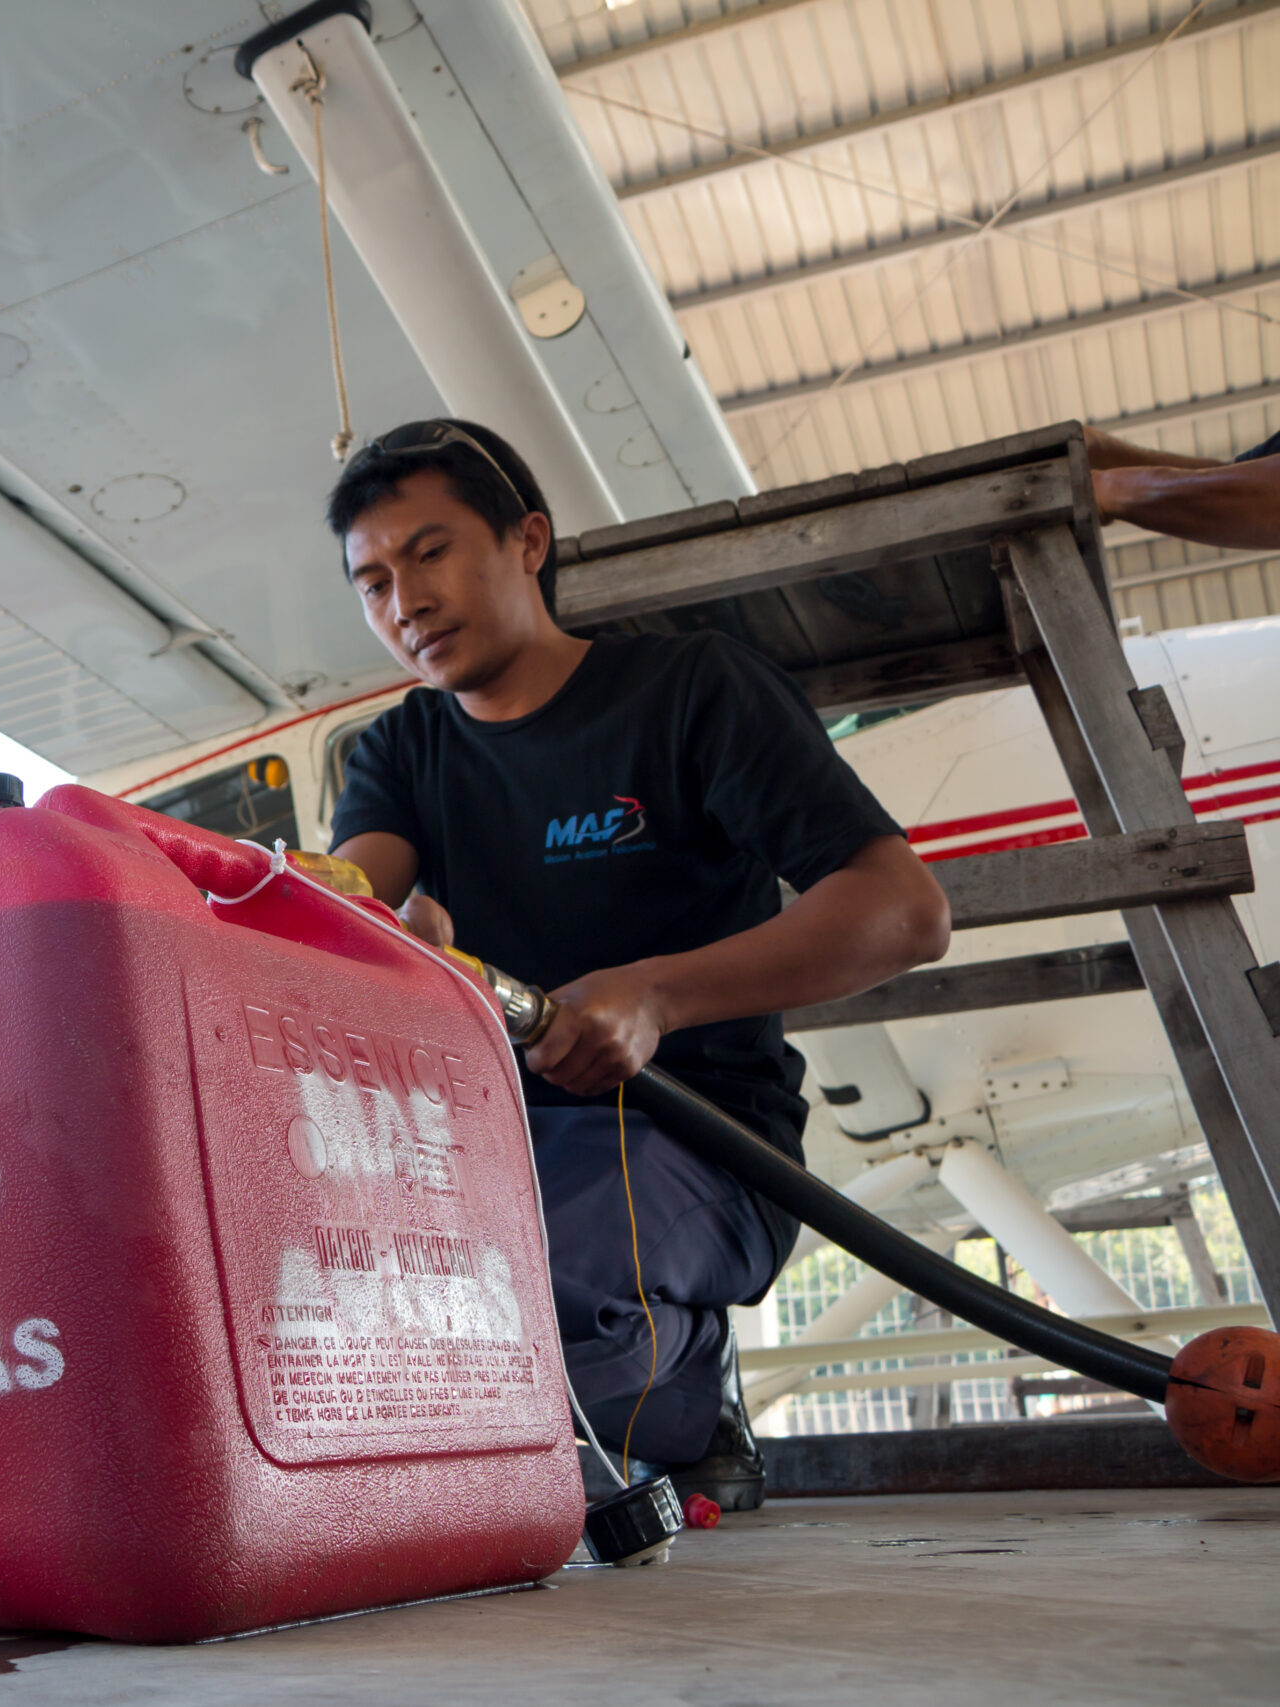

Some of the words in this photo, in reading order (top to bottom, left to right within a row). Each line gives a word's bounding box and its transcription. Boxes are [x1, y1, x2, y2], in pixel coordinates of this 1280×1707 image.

[545, 808, 624, 848] MAF
[243, 1000, 475, 1118] ESSENCE
[262, 1305, 334, 1322] ATTENTION
[324, 1337, 336, 1350] CE
[375, 1337, 394, 1350] PEUT
[397, 1337, 427, 1350] CAUSER
[430, 1338, 445, 1350] DES
[267, 1354, 322, 1368] ENTRAINER
[326, 1354, 339, 1367] LA
[342, 1354, 366, 1367] MORT
[388, 1354, 402, 1367] EST
[436, 1354, 445, 1366] NE
[271, 1373, 285, 1386] UN
[289, 1371, 333, 1385] MEDECIN
[412, 1370, 422, 1383] NE
[424, 1370, 438, 1383] PAS
[273, 1390, 288, 1405] DE
[293, 1390, 337, 1404] CHALEUR
[340, 1389, 353, 1403] OU
[416, 1387, 427, 1400] OU
[430, 1387, 448, 1400] PRES
[317, 1406, 342, 1421] HORS
[345, 1405, 358, 1421] DE
[361, 1406, 373, 1420] LA
[375, 1404, 407, 1419] PORTEE
[410, 1404, 426, 1417] DES
